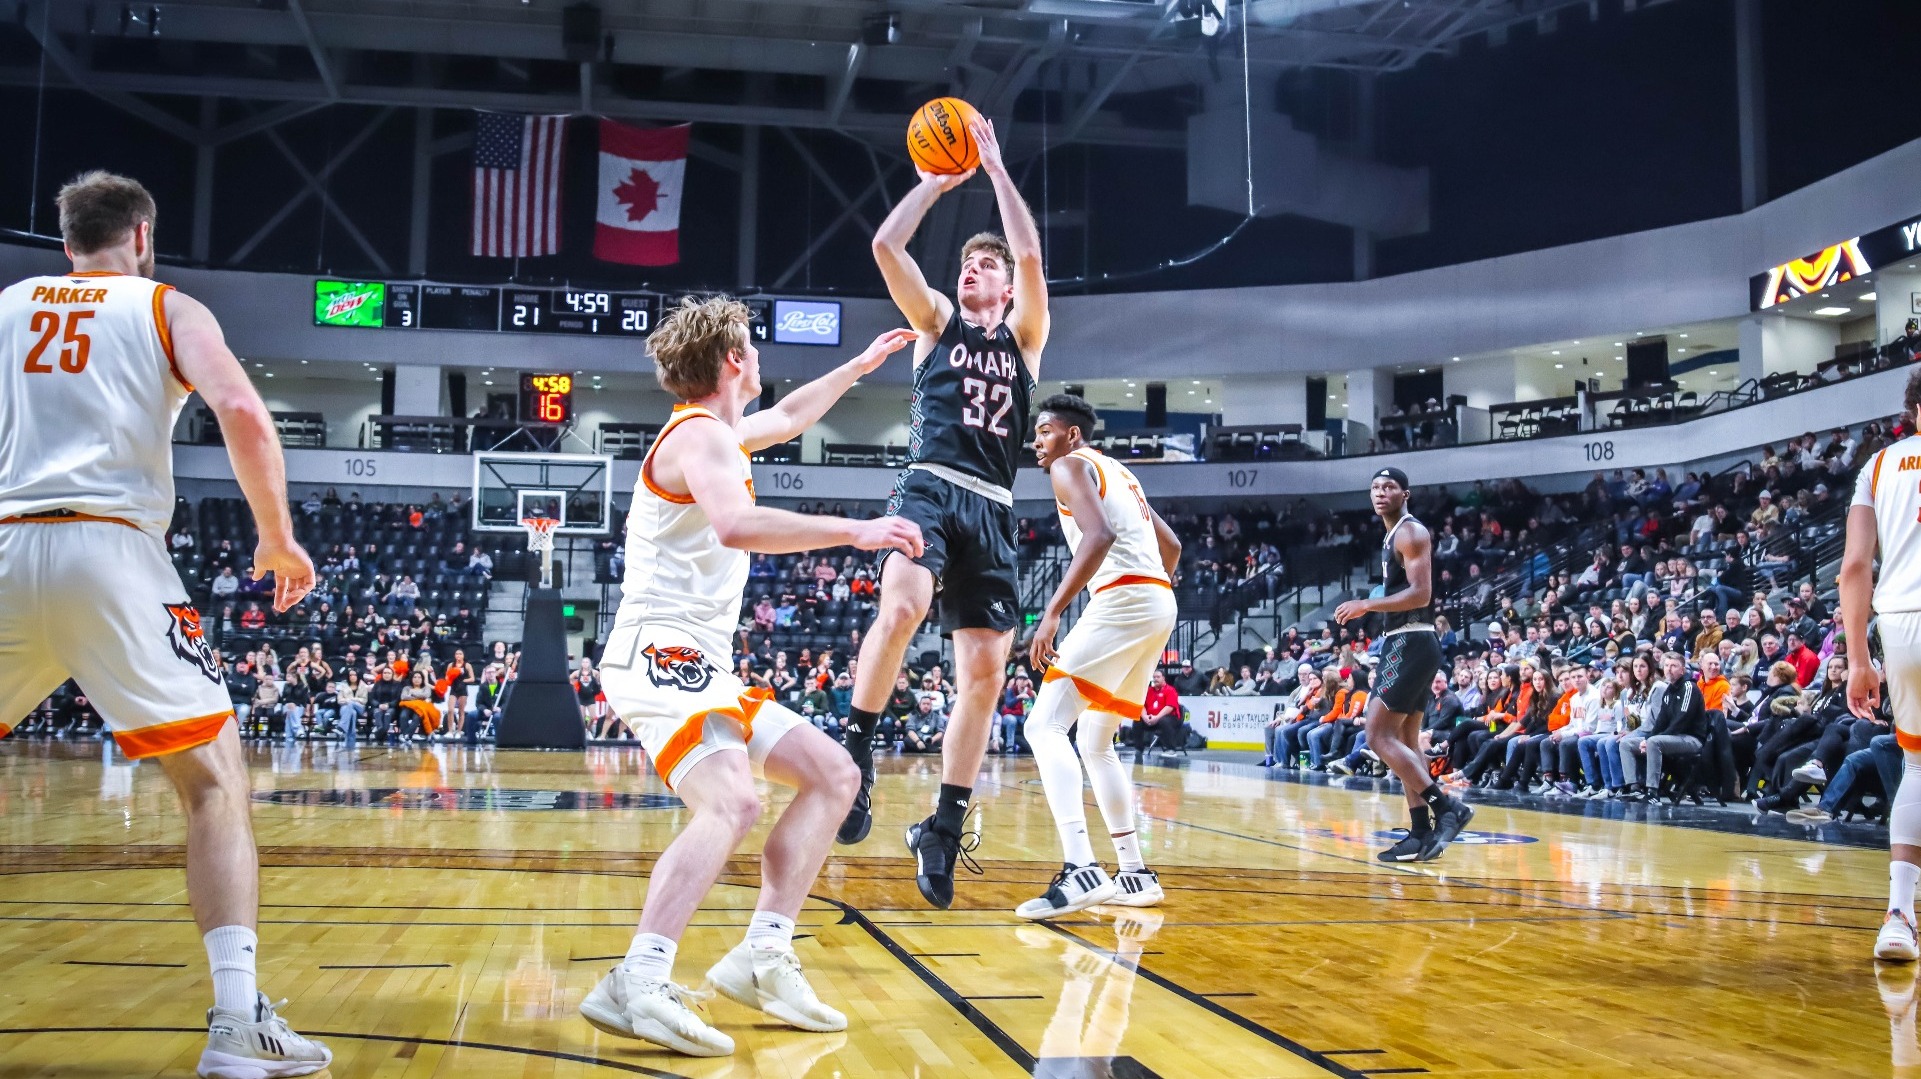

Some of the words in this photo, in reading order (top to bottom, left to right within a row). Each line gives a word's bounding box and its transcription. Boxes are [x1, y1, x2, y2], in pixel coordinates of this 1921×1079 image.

[930, 102, 957, 146] Wilson
[31, 286, 108, 304] PARKER
[425, 287, 451, 295] PLAYER
[461, 288, 490, 296] PENALTY
[513, 294, 539, 303] HOME
[566, 293, 609, 313] 4:59
[621, 298, 649, 307] GUEST
[401, 311, 412, 327] 3
[513, 305, 539, 326] 21
[622, 310, 648, 331] 20
[592, 318, 598, 333] 1
[755, 325, 767, 340] 4
[23, 311, 96, 374] 25
[532, 375, 571, 394] 4:58
[539, 393, 562, 420] 16
[962, 376, 1012, 437] 32
[1583, 440, 1614, 461] 108
[345, 458, 376, 476] 105
[772, 472, 804, 490] 106
[1228, 469, 1258, 488] 107
[1232, 713, 1246, 722] JAY
[1247, 713, 1269, 723] TAYLOR
